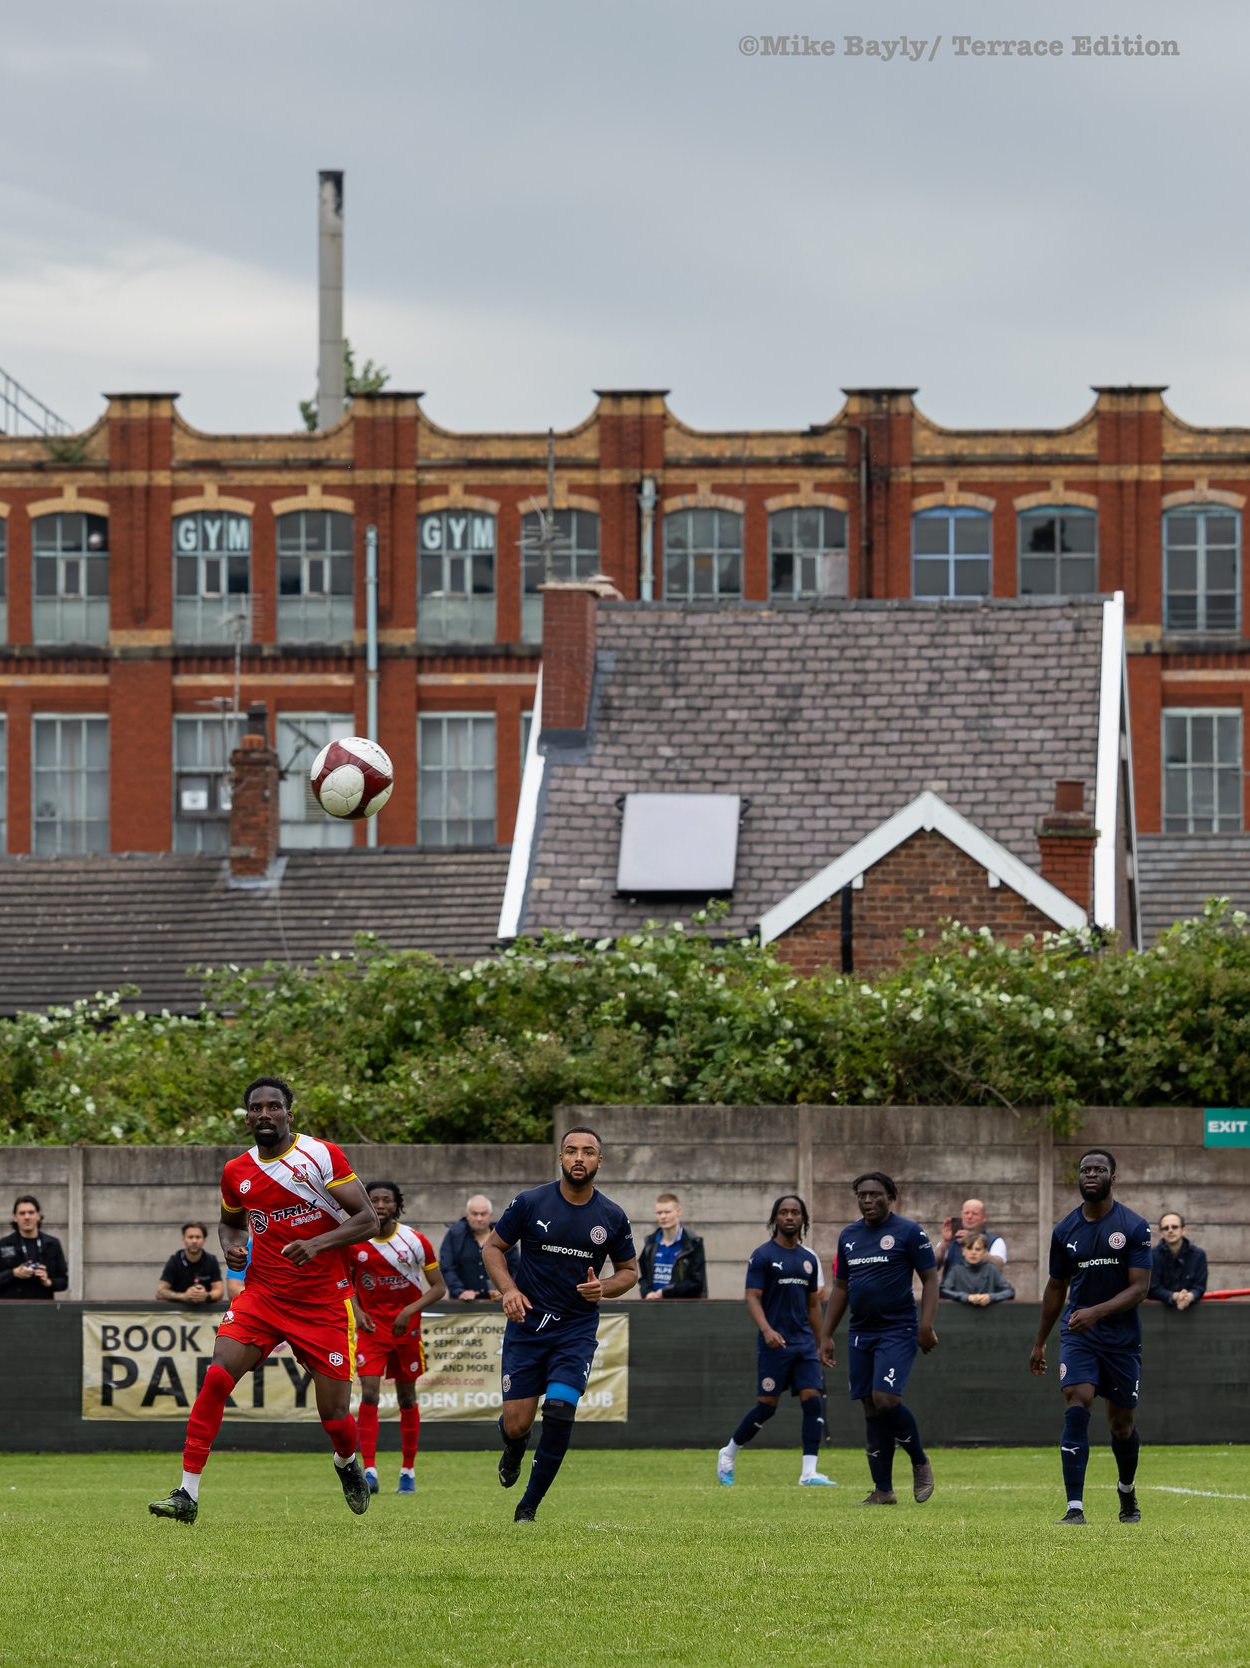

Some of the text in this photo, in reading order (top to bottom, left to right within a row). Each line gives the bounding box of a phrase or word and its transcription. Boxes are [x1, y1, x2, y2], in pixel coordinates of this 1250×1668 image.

[178, 519, 249, 551] GYM
[422, 517, 495, 550] GYM
[1207, 1120, 1248, 1133] EXIT
[541, 1244, 594, 1259] ONEFOOTBALL
[101, 1325, 202, 1352] BOOK
[433, 1339, 484, 1348] SEMINARS
[433, 1351, 488, 1360] WEDDINGS
[466, 1364, 495, 1373] MORE
[888, 1367, 895, 1378] 3
